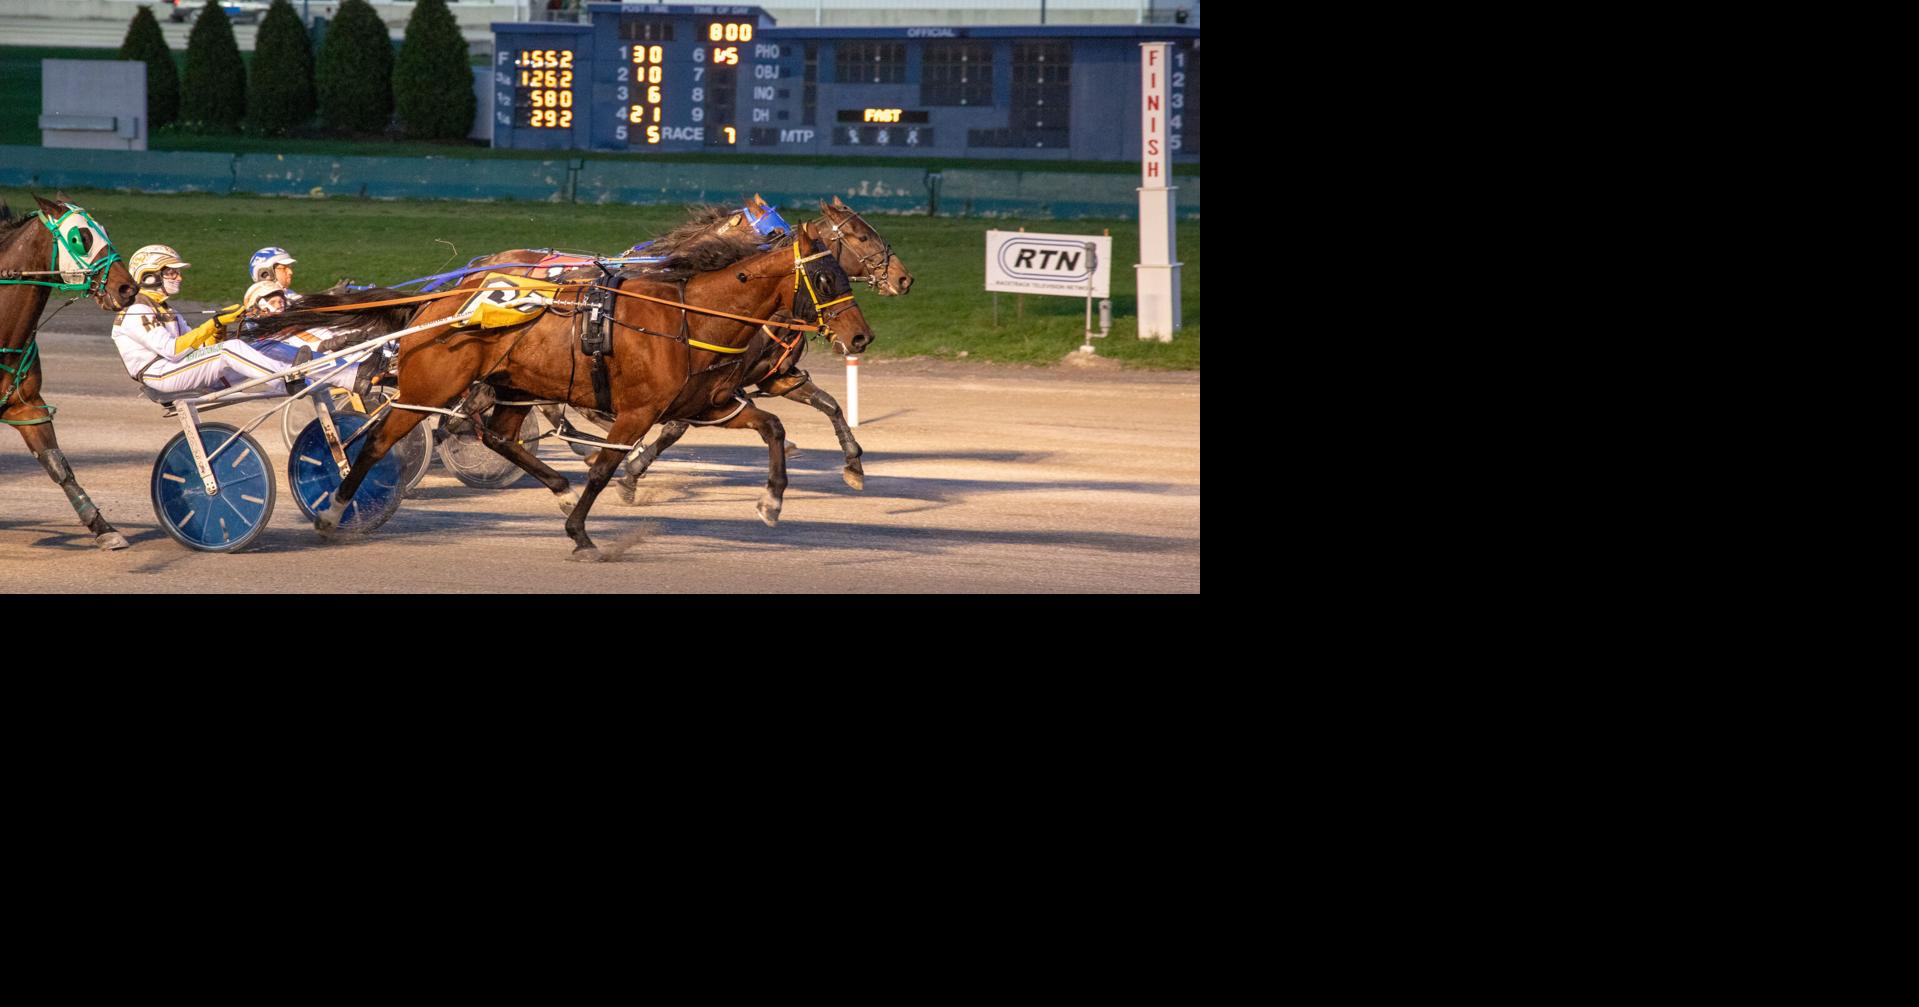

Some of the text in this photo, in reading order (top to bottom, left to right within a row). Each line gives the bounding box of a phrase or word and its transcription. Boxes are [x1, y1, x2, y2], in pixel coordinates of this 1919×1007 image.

[693, 6, 749, 14] TIME OF DAY
[907, 28, 954, 38] OFFICIAL
[498, 51, 509, 66] F
[618, 45, 663, 63] 1 30
[692, 48, 705, 62] 6
[755, 45, 779, 59] PHO
[1175, 53, 1185, 67] 1
[521, 70, 573, 88] 1262
[617, 66, 663, 83] 2 10
[693, 68, 704, 81] 7
[755, 65, 779, 79] OBJ
[1172, 73, 1185, 88] 2
[530, 90, 573, 107] 580
[617, 86, 661, 103] 3 6
[692, 88, 704, 102] 8
[754, 87, 774, 100] INQ
[1172, 94, 1184, 108] 3
[530, 109, 573, 127] 292
[616, 106, 628, 120] 4
[692, 107, 704, 122] 9
[753, 108, 770, 122] DH
[864, 108, 902, 122] FAST
[1147, 50, 1159, 177] FINISH
[1170, 115, 1182, 129] 4
[616, 125, 660, 144] 5 5
[662, 127, 736, 144] RACE 7
[781, 130, 814, 143] MTP
[1014, 248, 1081, 271] RTN
